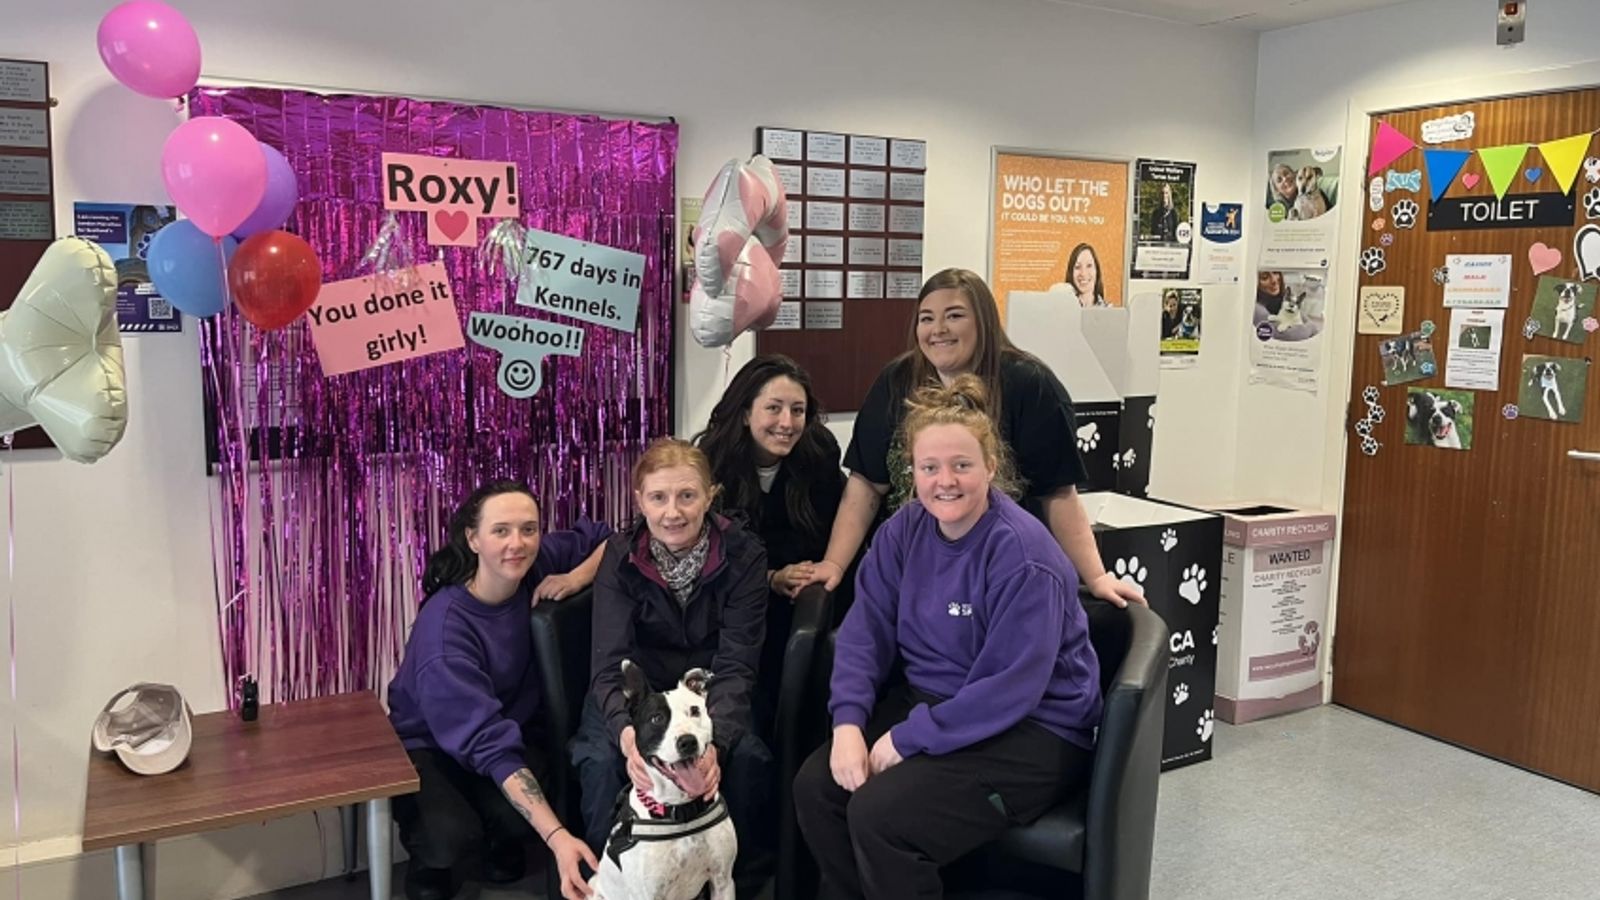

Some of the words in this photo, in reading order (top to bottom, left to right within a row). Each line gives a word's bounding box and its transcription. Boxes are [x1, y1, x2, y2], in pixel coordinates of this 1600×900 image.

[387, 163, 517, 214] Roxy!
[1003, 175, 1042, 192] WHO
[1045, 177, 1076, 194] LET
[1078, 180, 1110, 197] THE
[1002, 193, 1046, 211] DOGS
[1049, 196, 1092, 213] OUT?
[1460, 200, 1540, 222] TOILET
[1001, 212, 1010, 221] IT
[1010, 212, 1038, 222] COULD
[1039, 213, 1049, 223] BE
[526, 246, 565, 271] 767
[570, 256, 617, 286] days
[623, 267, 641, 290] in
[308, 302, 357, 326] You
[364, 286, 425, 315] done
[432, 280, 449, 300] it
[534, 285, 621, 321] Kennels.
[366, 323, 428, 361] girly!
[471, 316, 582, 350] Woohoo!!
[1252, 526, 1286, 538] CHARITY
[1286, 522, 1329, 536] RECYCLING
[1269, 548, 1311, 565] WANTED
[1254, 571, 1285, 582] CHARITY
[1169, 630, 1195, 652] CA
